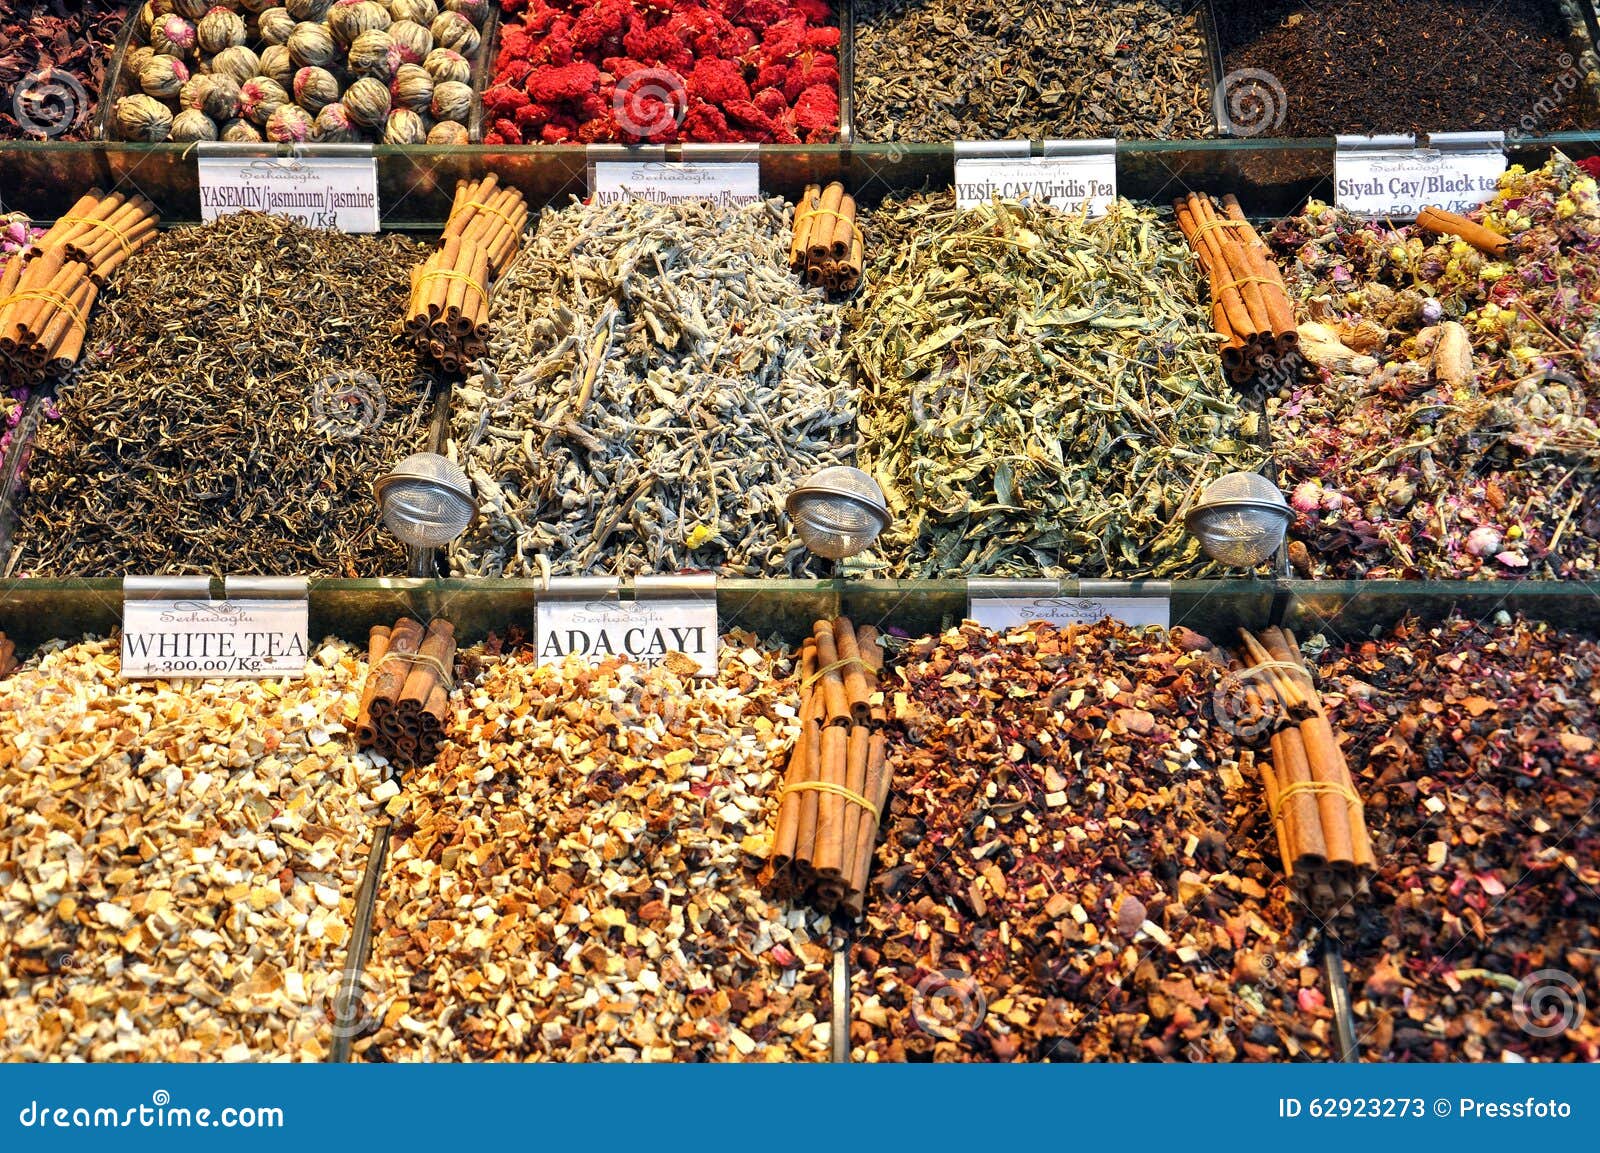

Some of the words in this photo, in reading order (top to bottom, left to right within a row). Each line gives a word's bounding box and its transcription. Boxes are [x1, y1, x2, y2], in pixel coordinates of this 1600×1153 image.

[1088, 179, 1114, 197] Tea
[1338, 177, 1384, 200] Siyah
[125, 632, 236, 658] WHITE
[244, 631, 307, 657] TEA
[540, 629, 616, 658] ADA
